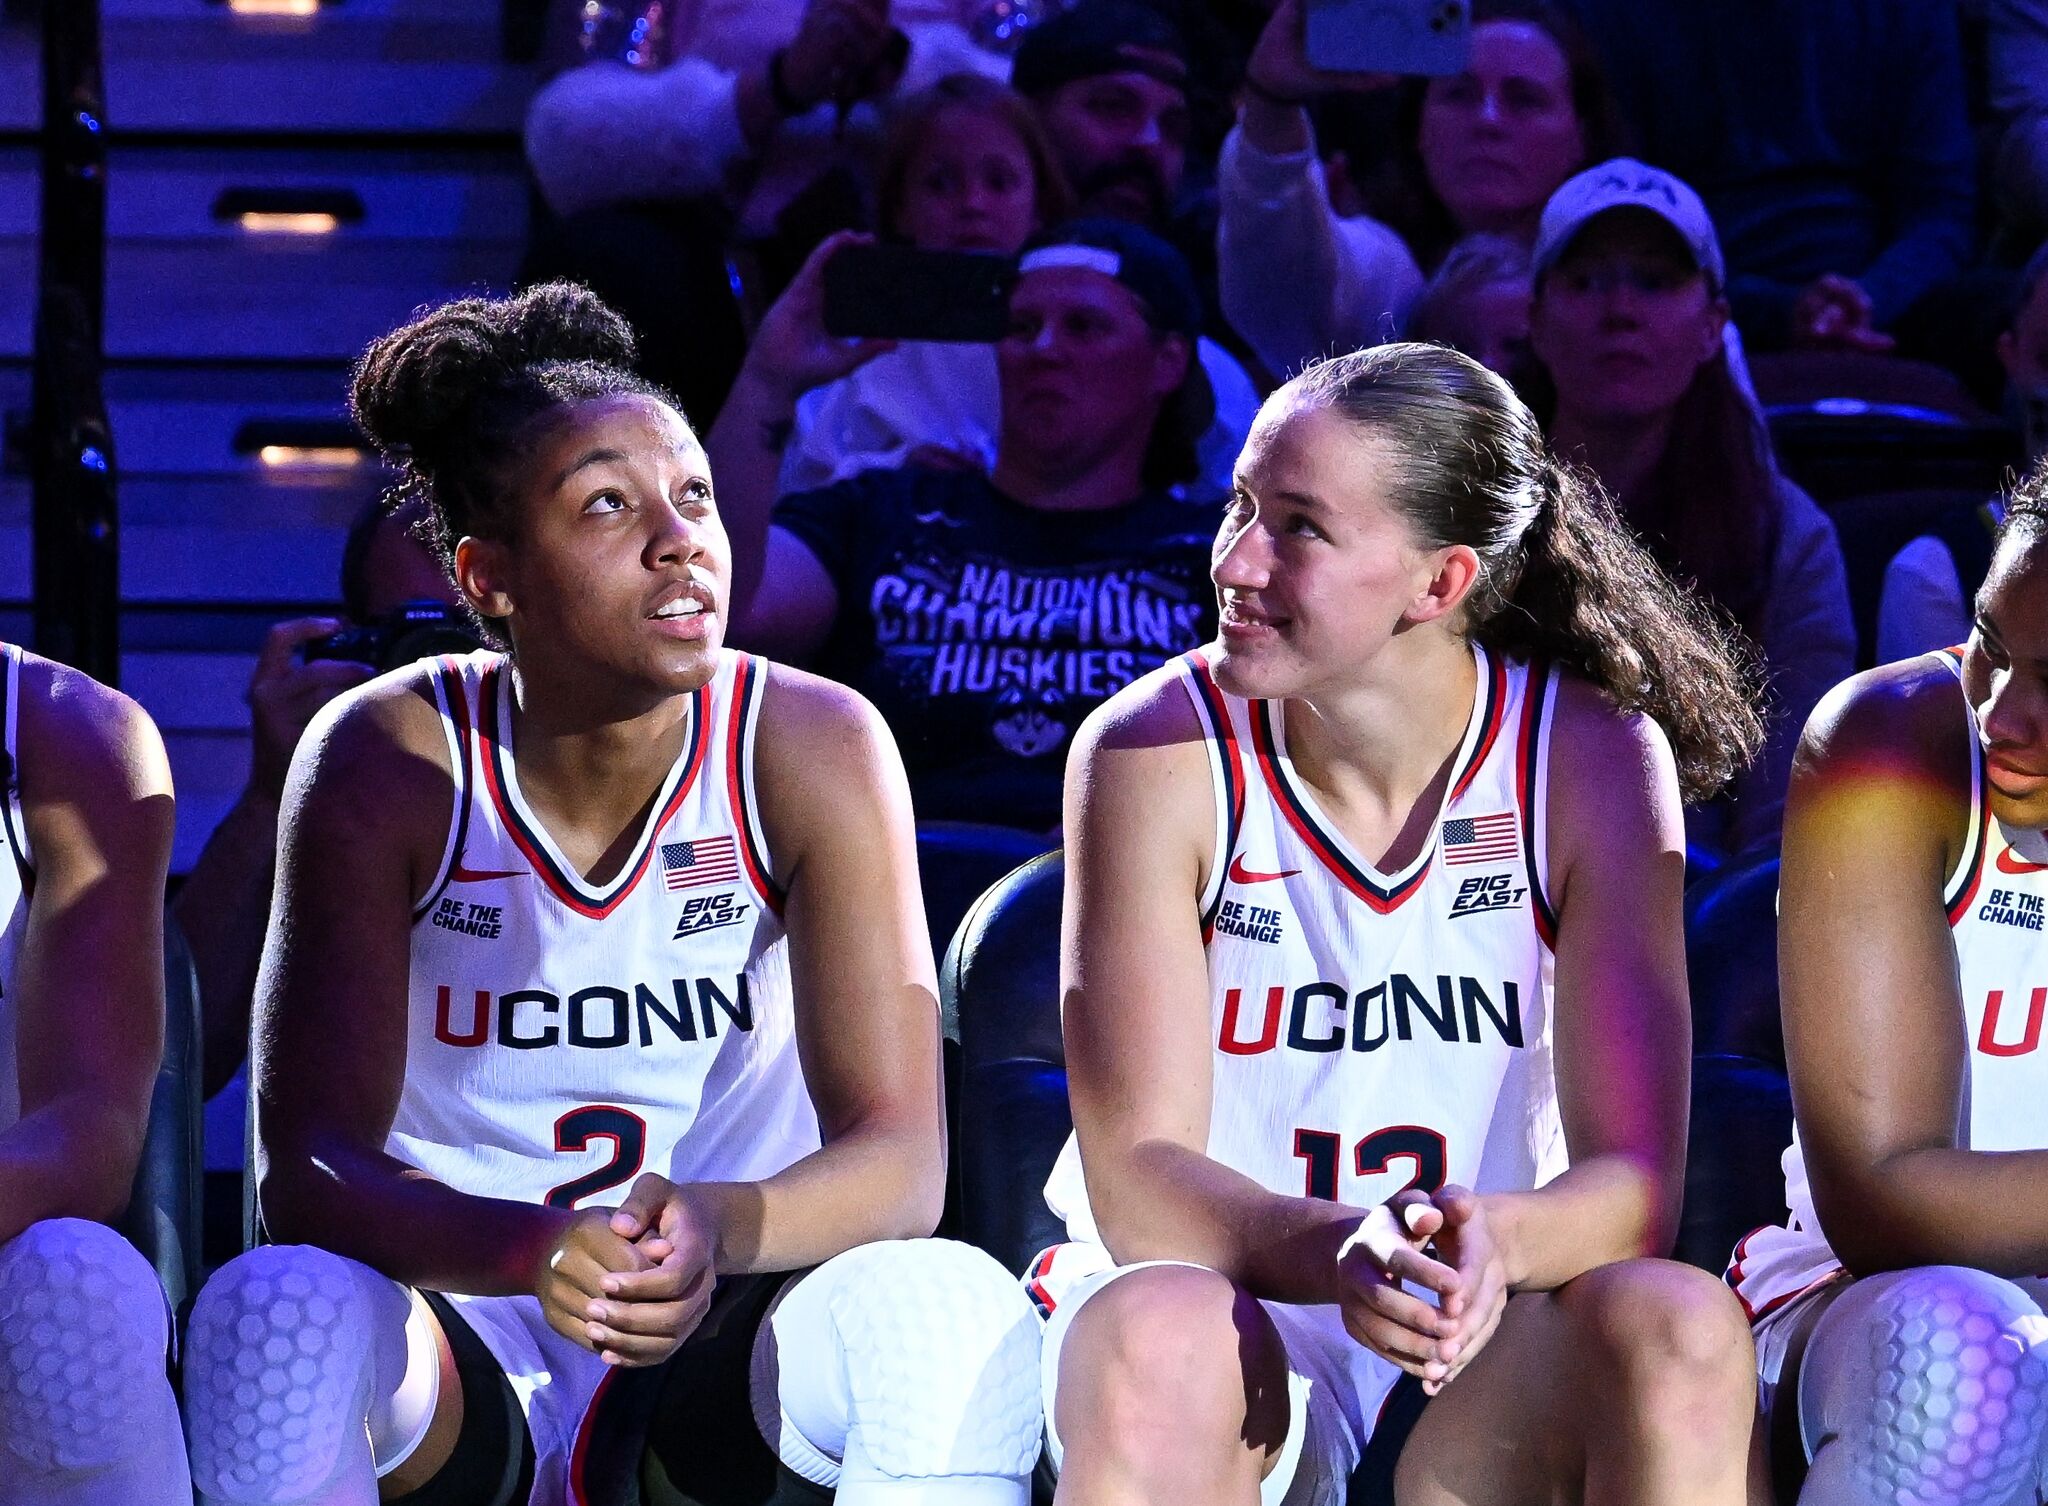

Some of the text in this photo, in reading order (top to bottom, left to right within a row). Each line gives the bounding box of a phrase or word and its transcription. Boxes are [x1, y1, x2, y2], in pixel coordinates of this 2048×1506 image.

[929, 641, 1136, 697] HUSKIES
[1459, 874, 1512, 894] BIG
[440, 898, 502, 923] BE THE
[682, 892, 735, 915] BIG
[1452, 888, 1527, 910] EAST
[1989, 889, 2045, 913] BE THE
[432, 911, 502, 939] CHANGE
[677, 904, 750, 930] EAST
[1221, 900, 1281, 926] BE THE
[1979, 905, 2045, 931] CHANGE
[1215, 915, 1283, 944] CHANGE
[435, 972, 754, 1050] UCONN
[1218, 974, 1524, 1055] UCONN
[544, 1104, 646, 1211] 2
